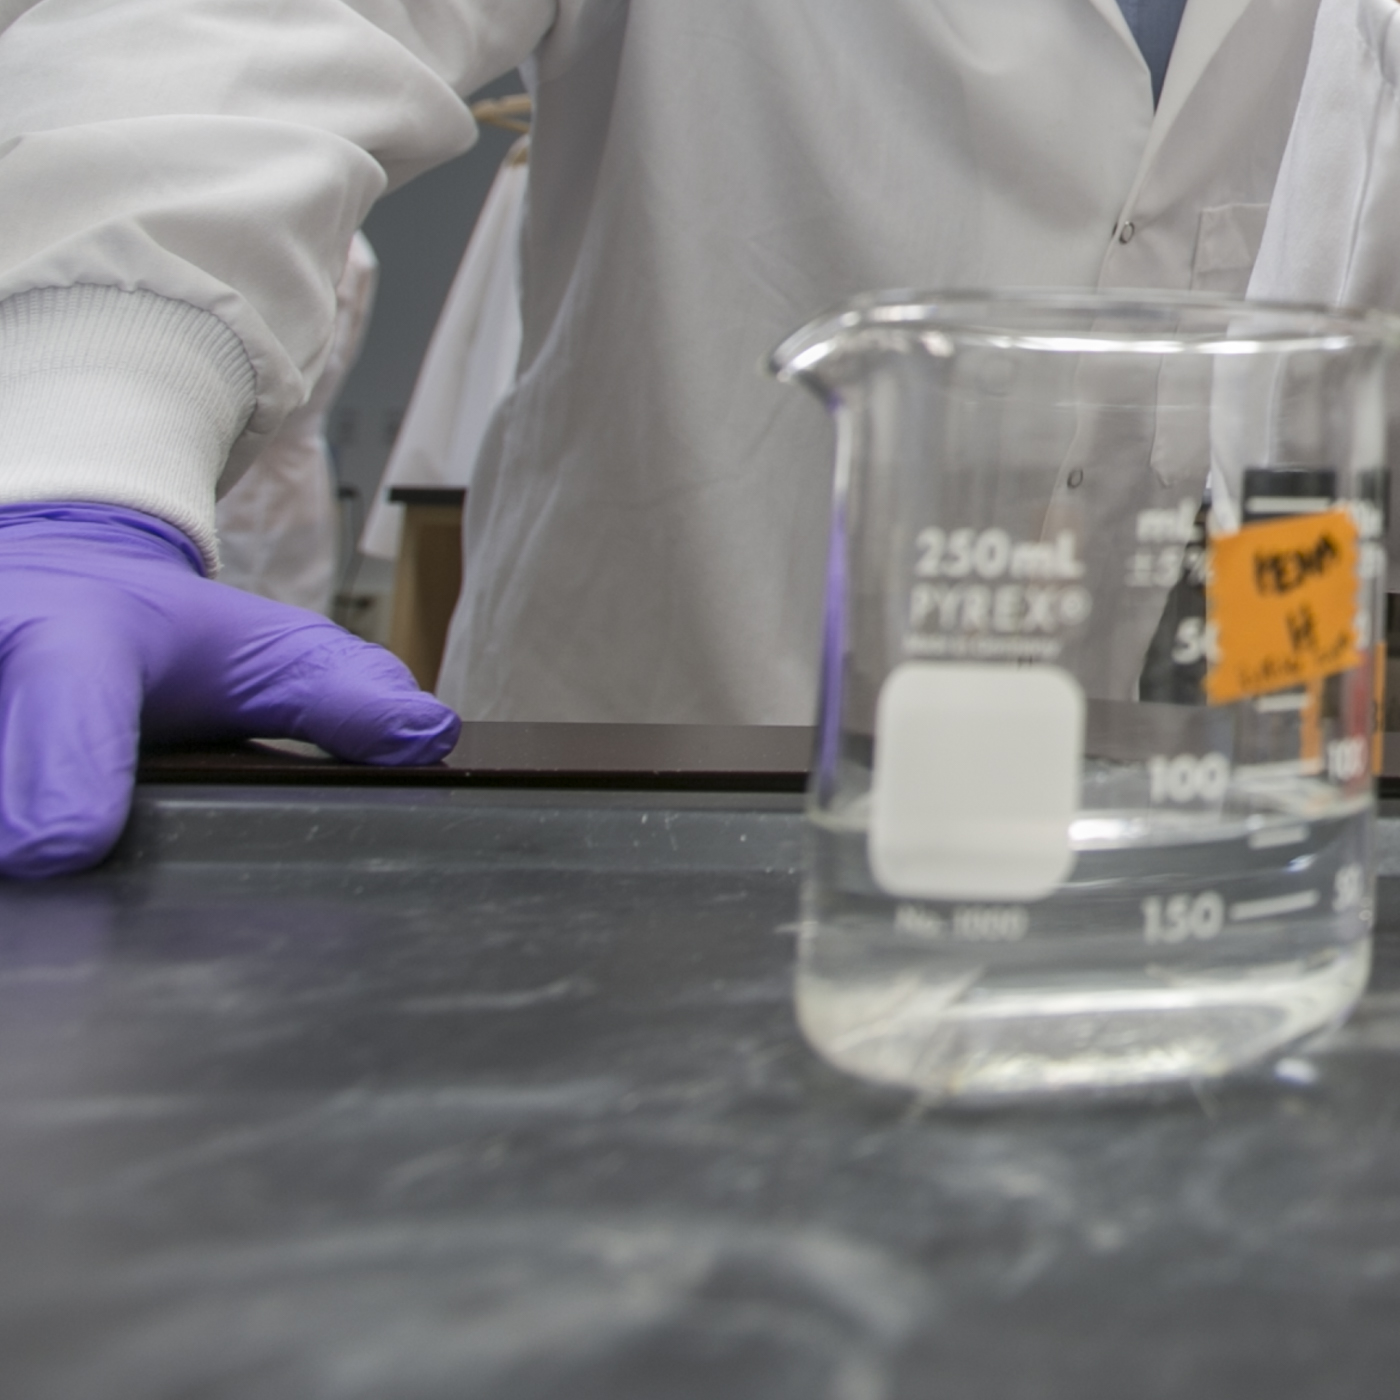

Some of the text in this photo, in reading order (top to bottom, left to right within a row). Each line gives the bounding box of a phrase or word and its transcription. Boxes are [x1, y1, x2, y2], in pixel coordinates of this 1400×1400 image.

[914, 524, 1087, 580] 250mL
[1148, 752, 1232, 803] 100
[1142, 891, 1225, 945] 150
